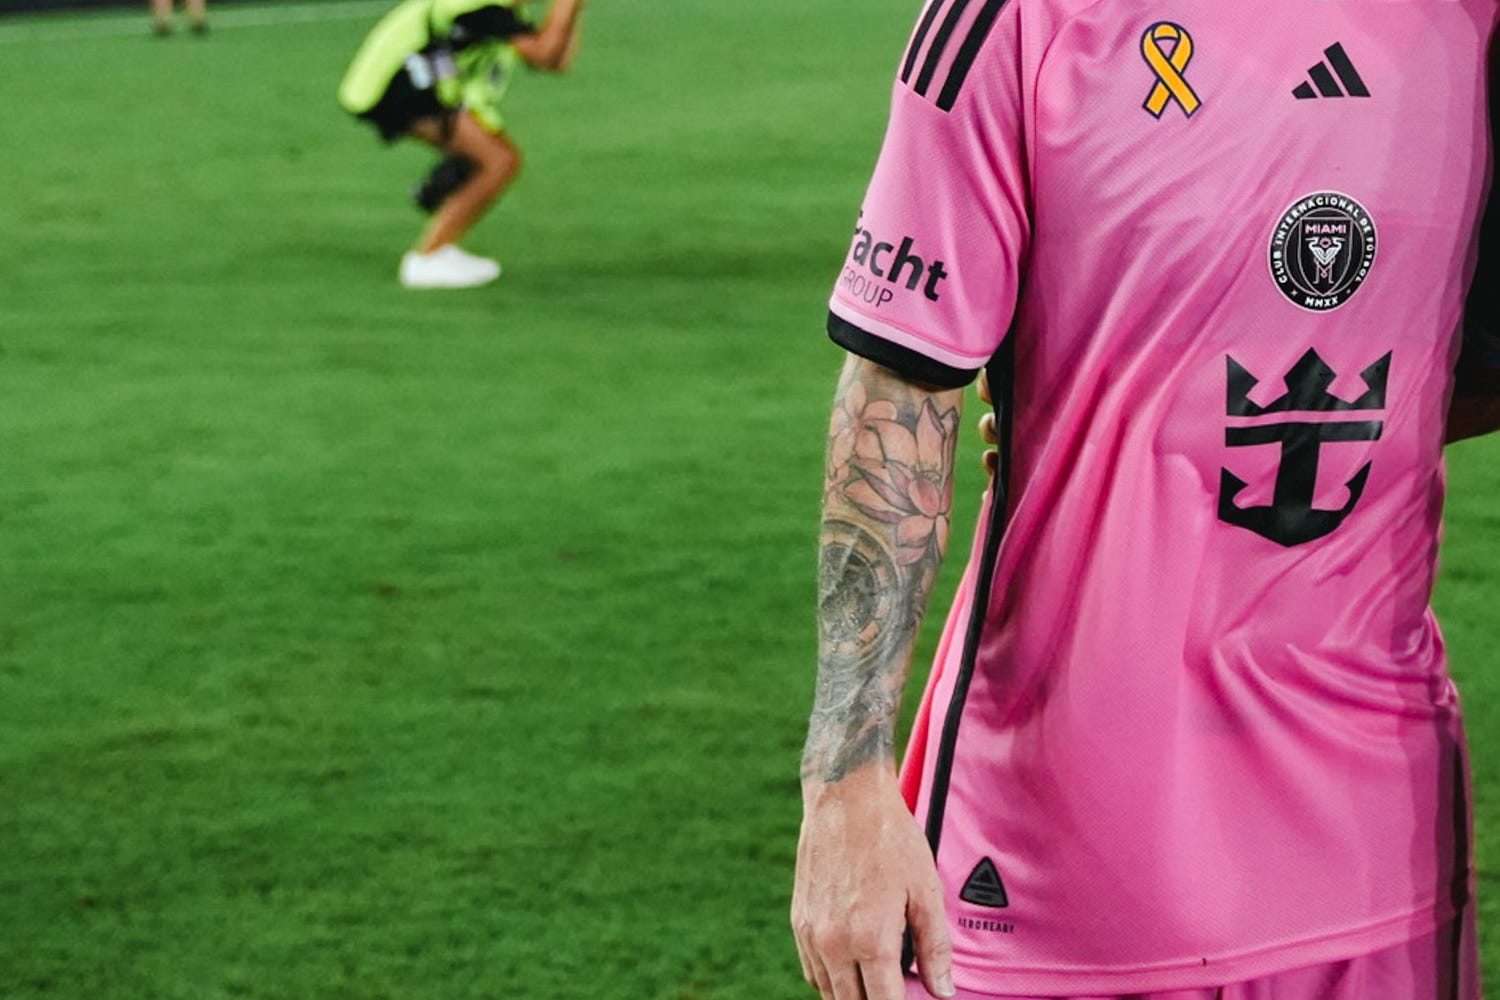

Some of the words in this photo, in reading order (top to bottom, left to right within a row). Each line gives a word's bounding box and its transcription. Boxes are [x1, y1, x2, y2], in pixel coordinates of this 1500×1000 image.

[1274, 196, 1360, 246] INTERNACIONAL
[1304, 223, 1347, 234] MIAMI
[1359, 217, 1372, 233] DE
[854, 209, 949, 302] acht
[1272, 250, 1288, 284] CLUB
[843, 265, 894, 308] ROUP
[1304, 296, 1339, 307] MMXX
